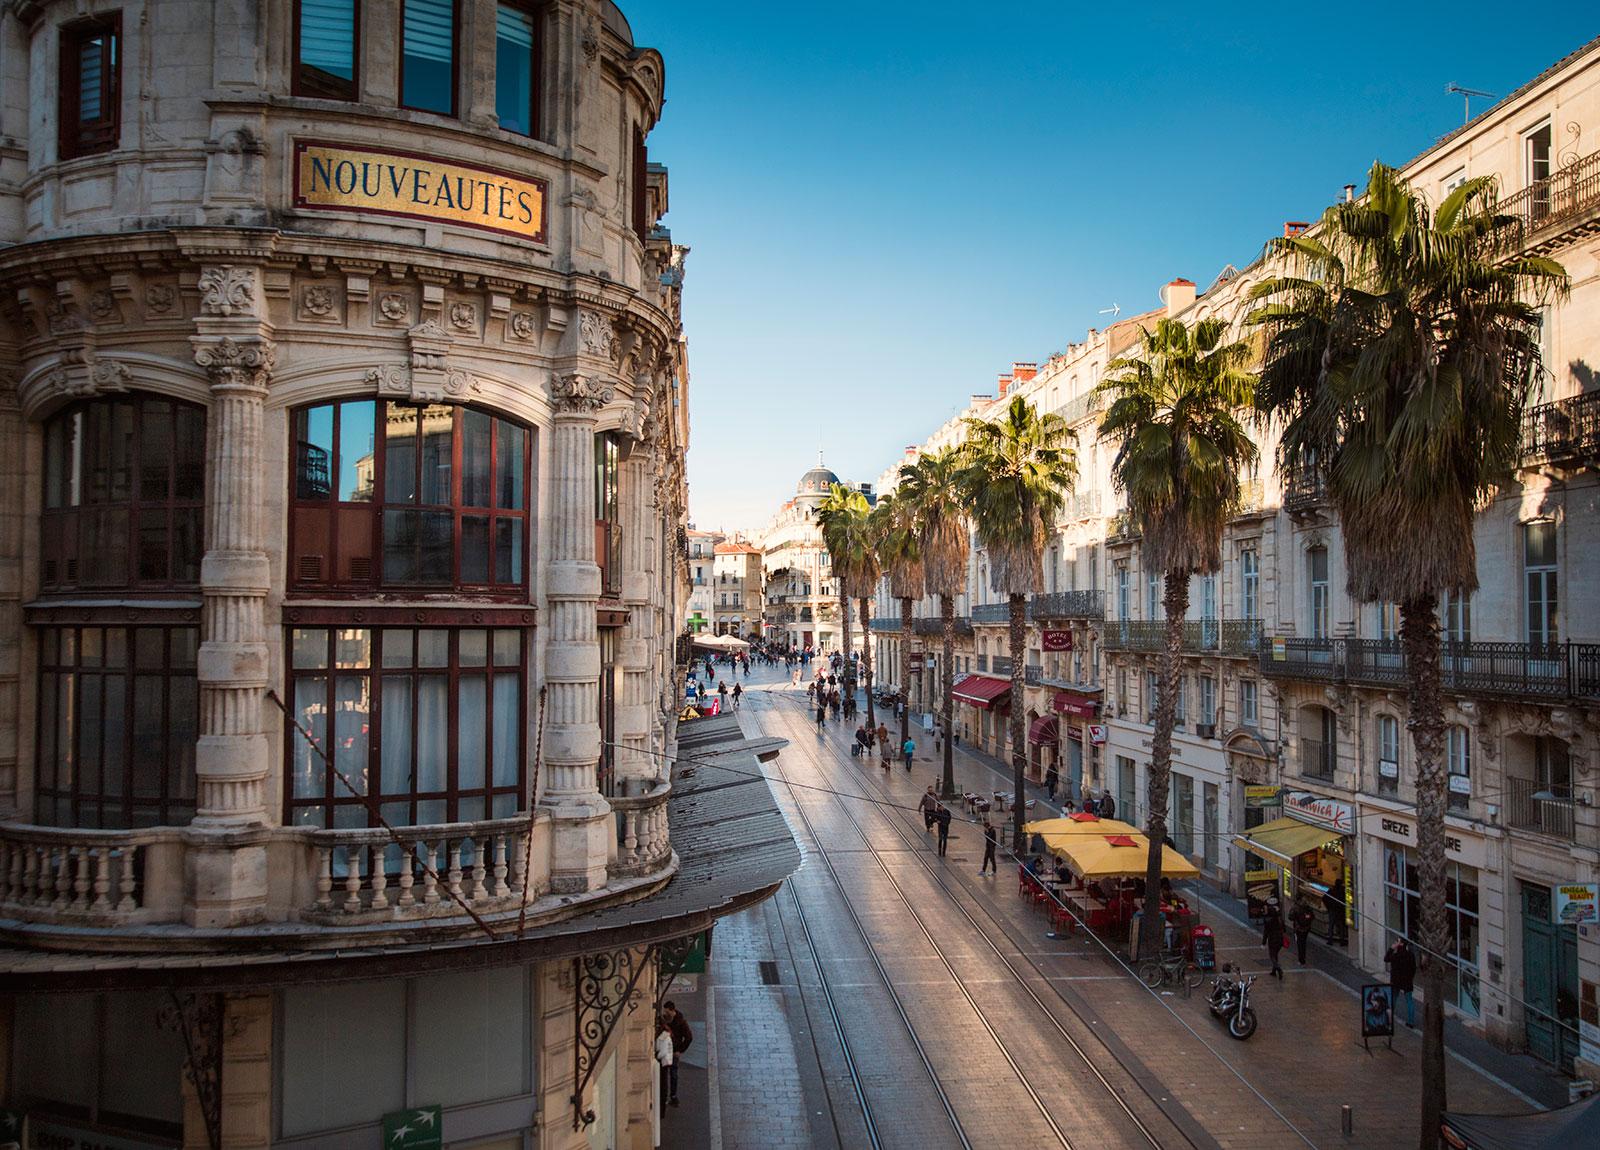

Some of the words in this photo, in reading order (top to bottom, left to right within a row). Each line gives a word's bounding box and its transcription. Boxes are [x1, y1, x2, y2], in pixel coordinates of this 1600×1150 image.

[311, 157, 533, 224] NOUVEAUTÉS
[1285, 793, 1333, 817] Sanwich
[1382, 818, 1409, 837] GREZE
